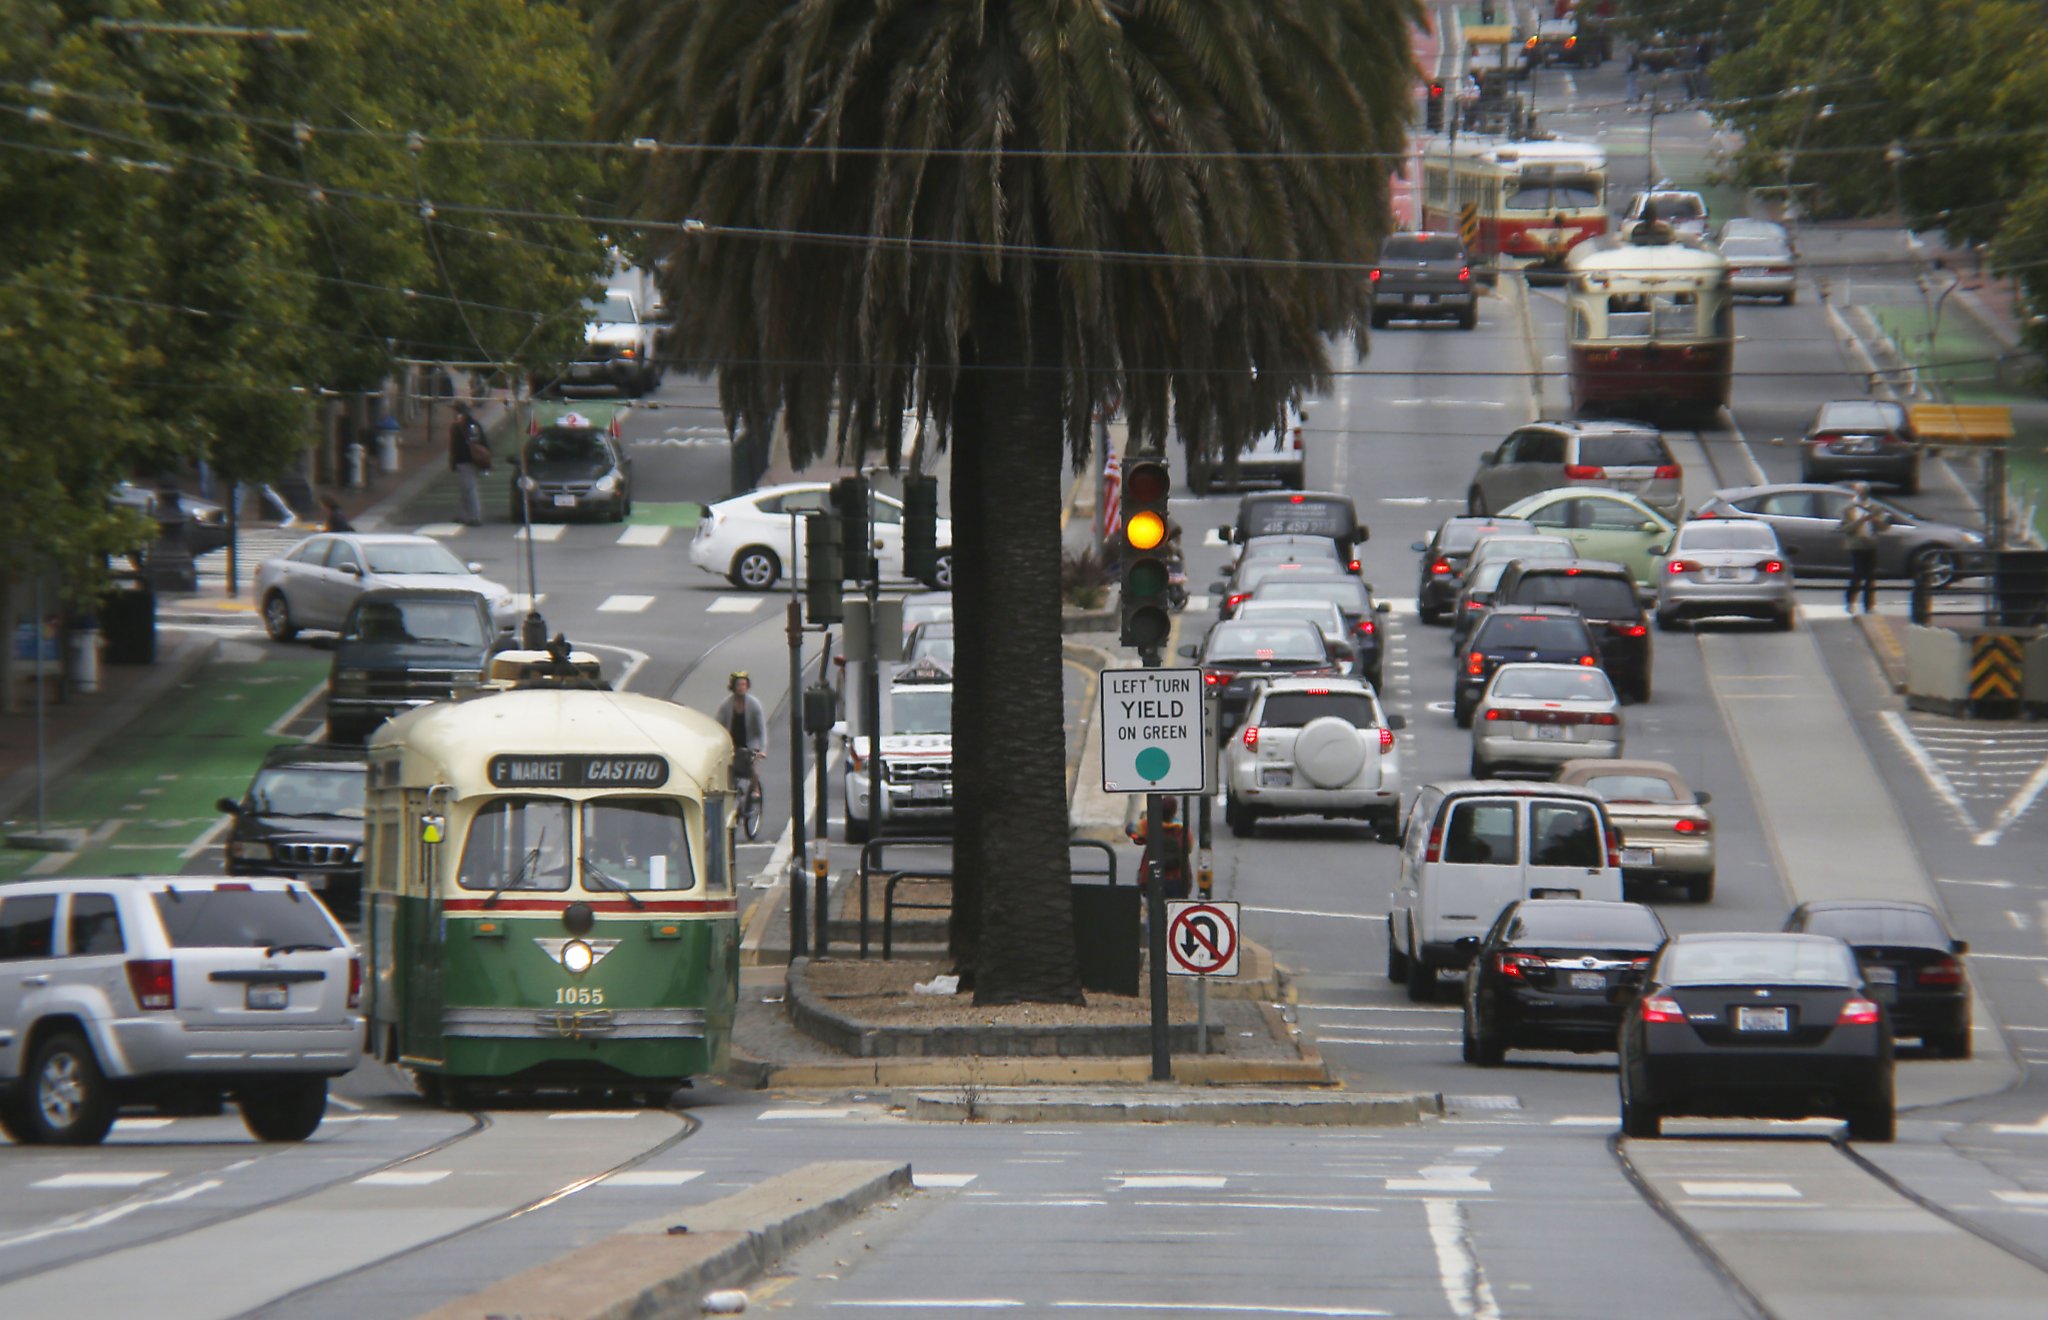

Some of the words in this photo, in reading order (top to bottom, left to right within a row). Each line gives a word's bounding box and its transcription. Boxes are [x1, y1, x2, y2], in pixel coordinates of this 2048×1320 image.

[1113, 679, 1147, 694] LEFT
[1155, 678, 1190, 693] TURN
[1121, 700, 1184, 719] YIELD
[1118, 726, 1136, 740] ON
[1143, 725, 1187, 740] GREEN
[496, 762, 507, 780] F
[511, 761, 563, 780] MARKET
[587, 760, 660, 780] CASTRO
[555, 987, 605, 1005] 1055
